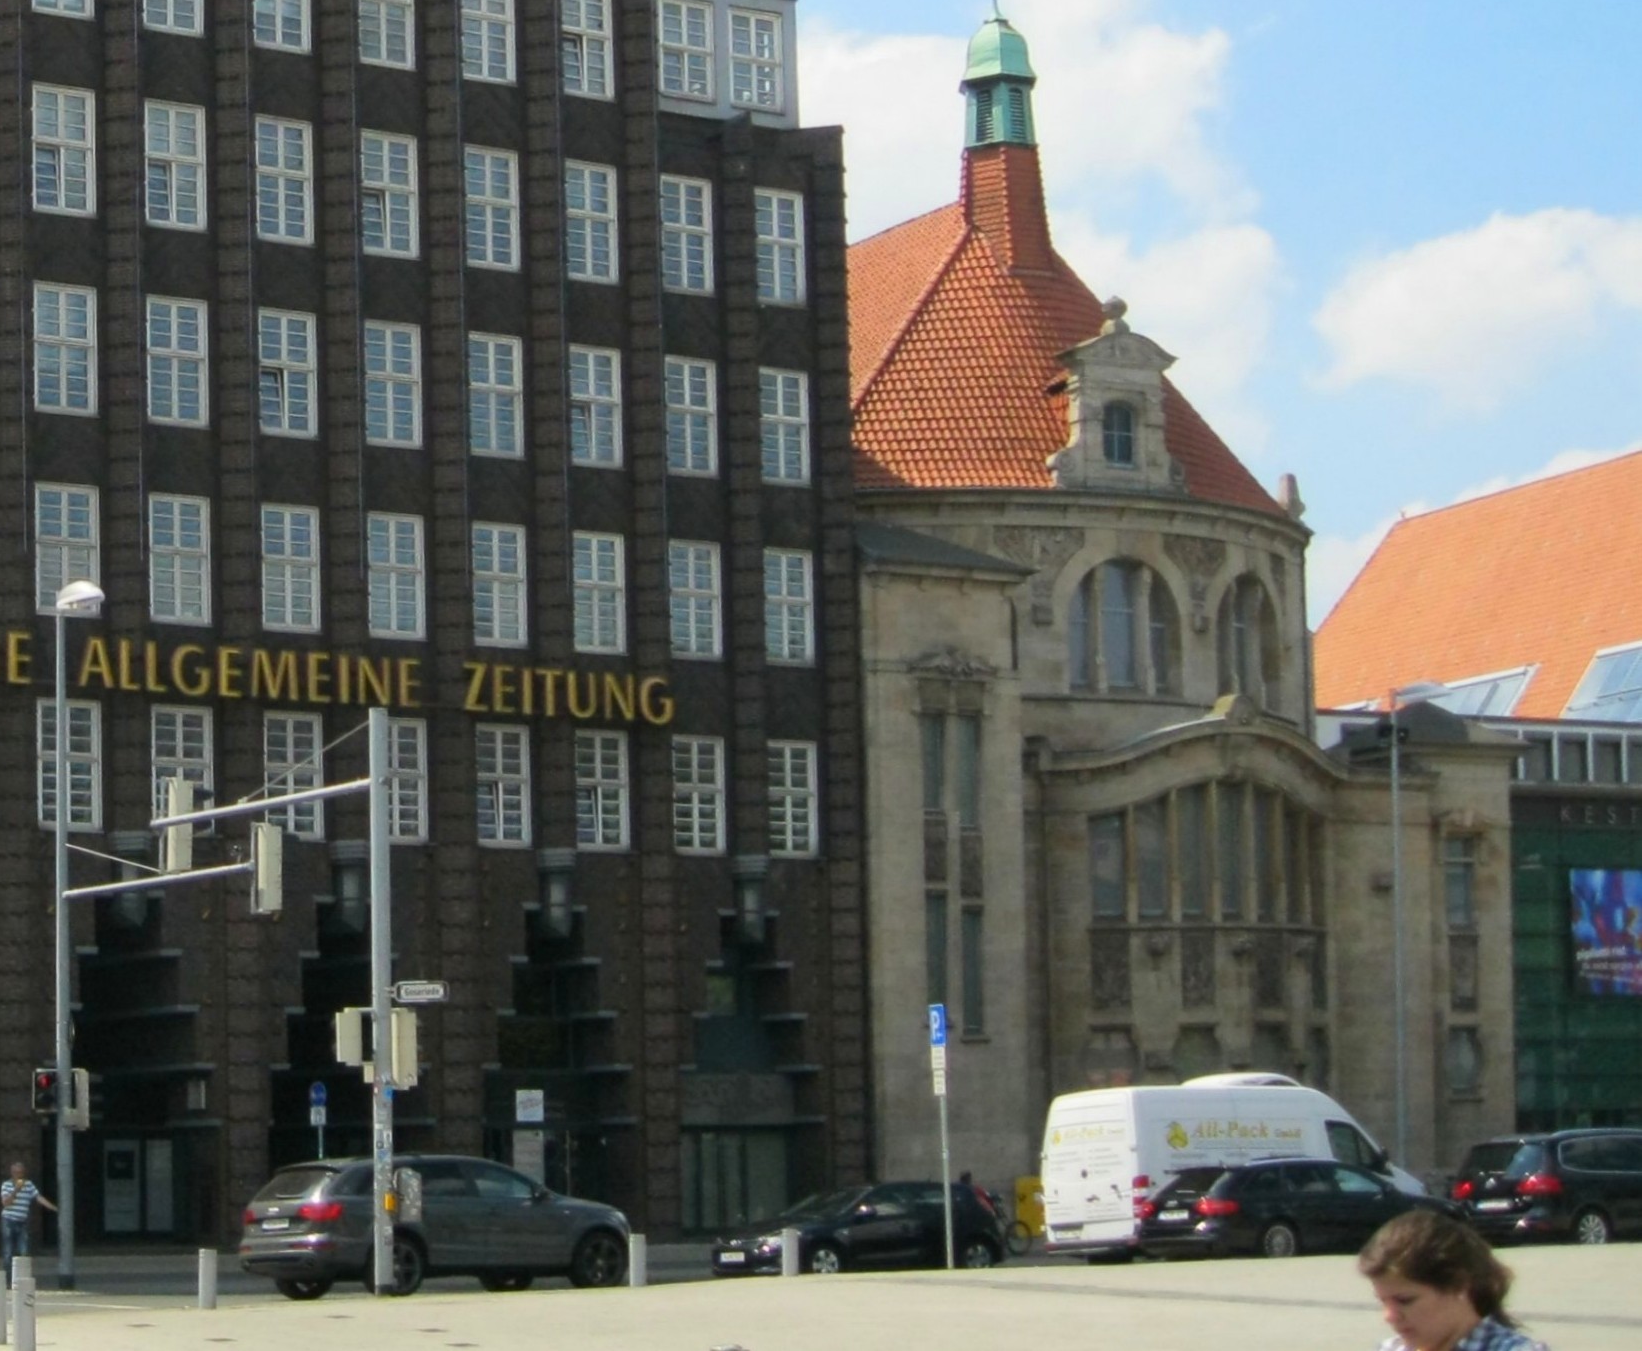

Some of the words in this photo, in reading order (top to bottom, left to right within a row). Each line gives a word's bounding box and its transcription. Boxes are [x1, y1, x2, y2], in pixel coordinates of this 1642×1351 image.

[77, 636, 422, 708] ALLGEMEINE
[462, 660, 676, 725] ZEITUNG
[1192, 1120, 1270, 1138] All-Pack
